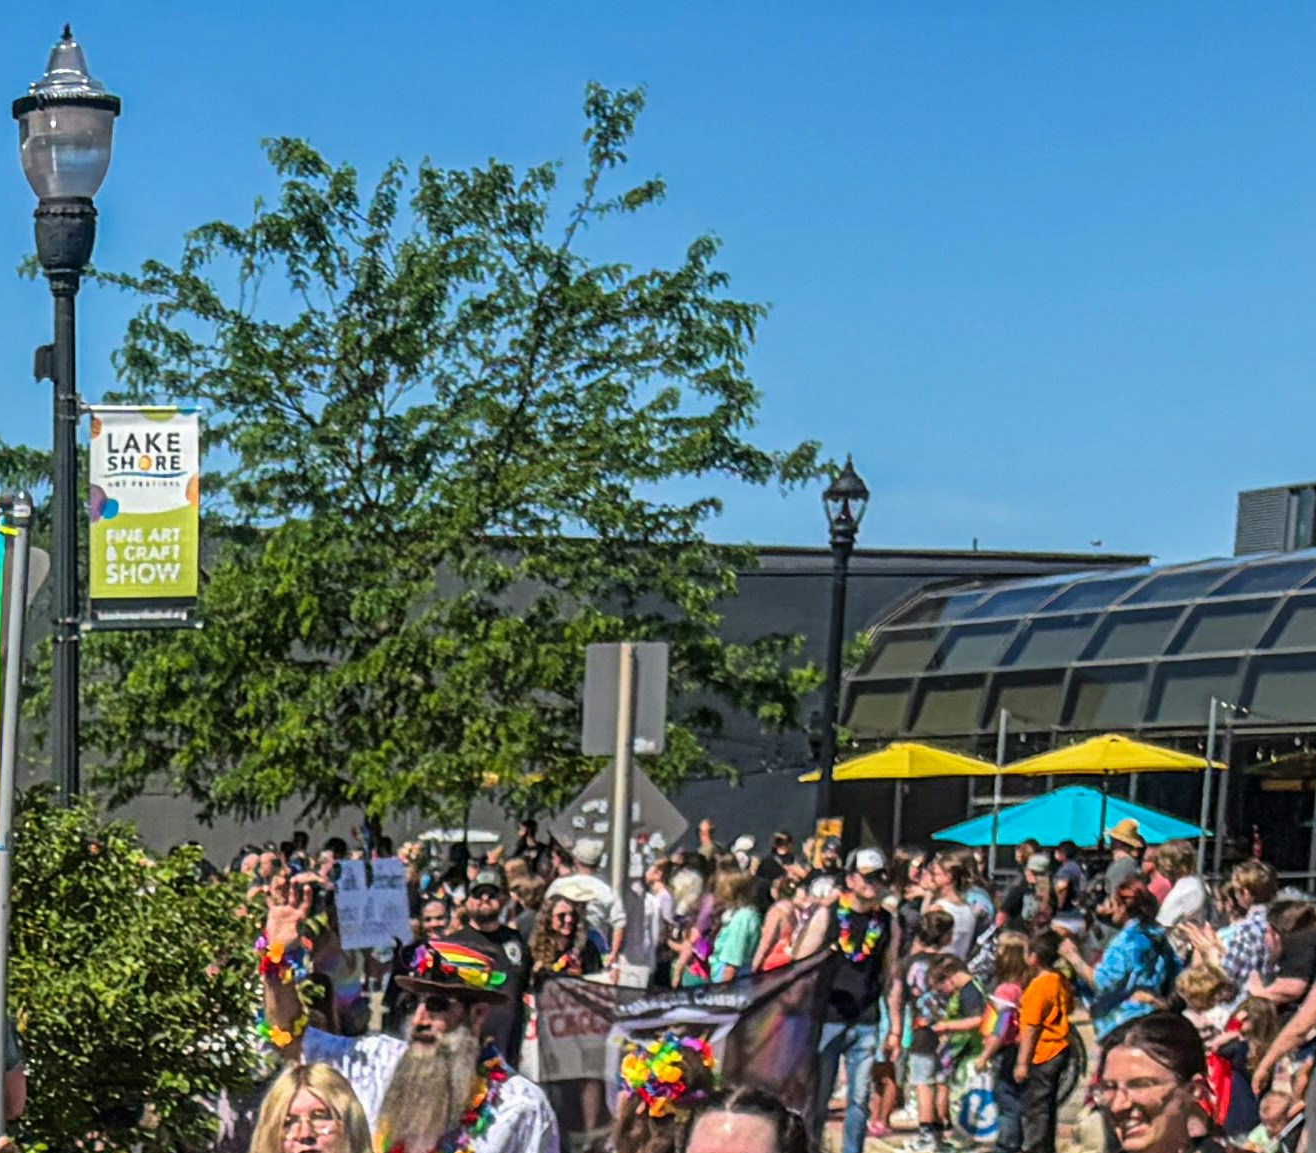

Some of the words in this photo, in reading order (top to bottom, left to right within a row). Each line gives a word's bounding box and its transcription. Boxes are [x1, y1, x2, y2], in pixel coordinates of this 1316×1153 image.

[107, 432, 181, 453] LAKE
[107, 453, 181, 471] SHORE
[106, 528, 143, 544] FINE
[147, 527, 181, 543] ART
[124, 545, 180, 561] CRAFT
[106, 563, 181, 585] SHOW
